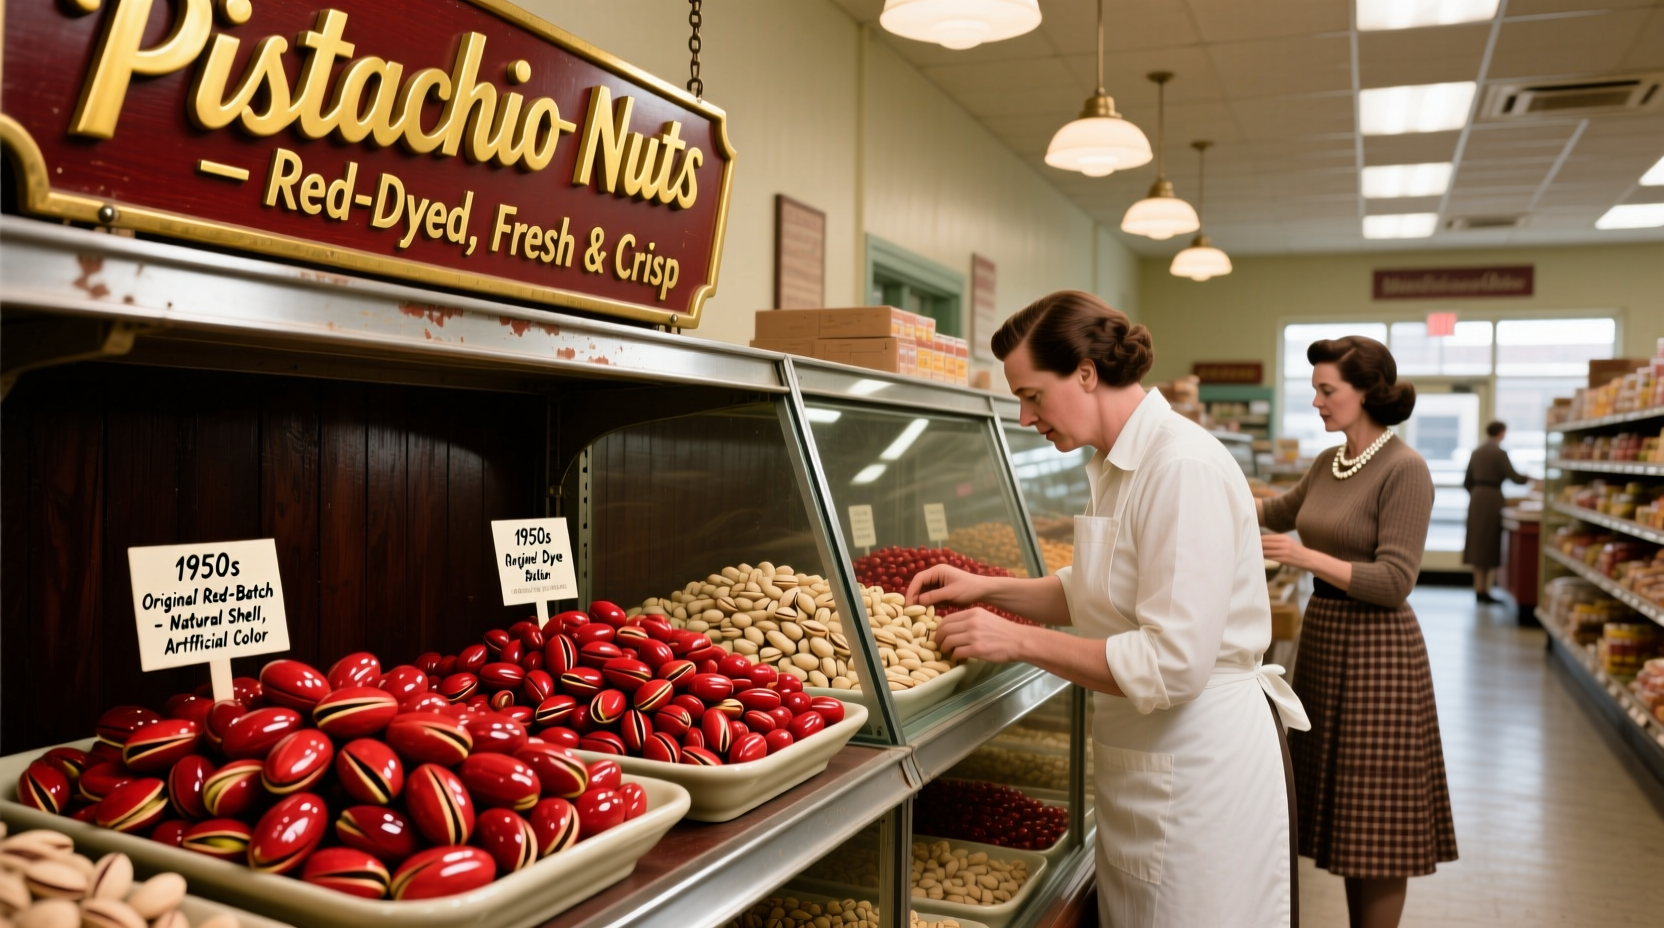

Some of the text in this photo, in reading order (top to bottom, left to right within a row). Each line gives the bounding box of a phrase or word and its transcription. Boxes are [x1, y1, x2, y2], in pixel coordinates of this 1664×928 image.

[70, 0, 703, 209] Pistachio Nuts
[264, 148, 478, 256] Red-Dyed,
[491, 204, 575, 267] Fresh
[584, 227, 606, 273] &
[615, 234, 679, 301] Crisp
[515, 527, 551, 546] 1950s
[175, 552, 240, 581] 1950s
[542, 549, 563, 566] Dye
[142, 582, 274, 613] Original Red-Batch
[170, 609, 222, 631] Natural
[228, 605, 266, 624] Shell,
[233, 627, 268, 646] Color
